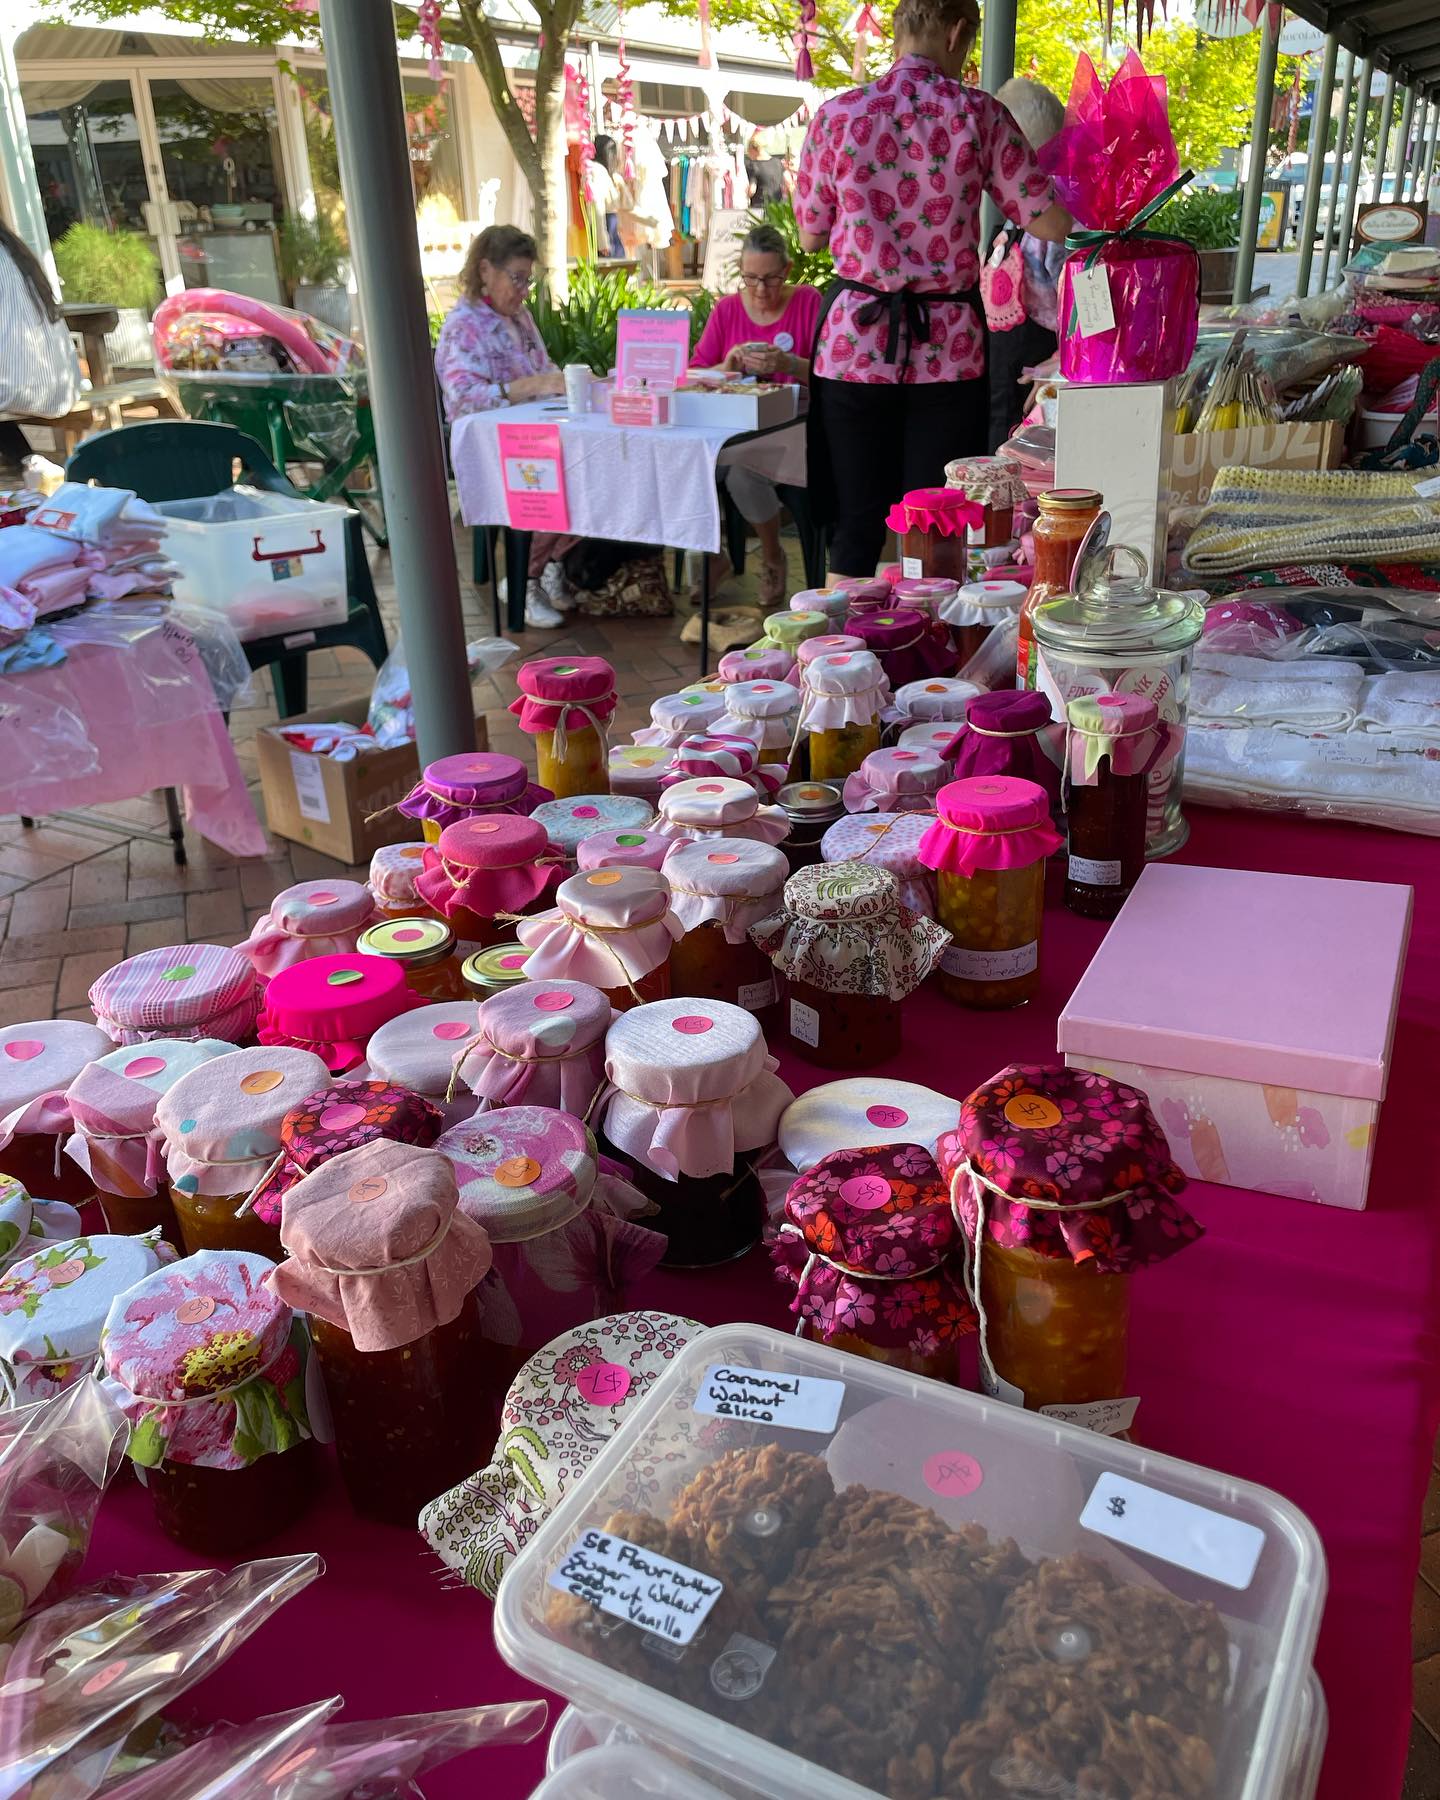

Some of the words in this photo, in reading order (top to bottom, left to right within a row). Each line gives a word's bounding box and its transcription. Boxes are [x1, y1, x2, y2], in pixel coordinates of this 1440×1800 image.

[714, 1369, 800, 1395] Caramel
[709, 1385, 785, 1407] Walnut
[1106, 1495, 1126, 1518] $
[582, 1532, 611, 1555] SR
[568, 1551, 630, 1581] Sugar
[628, 1606, 682, 1639] Vanilla
